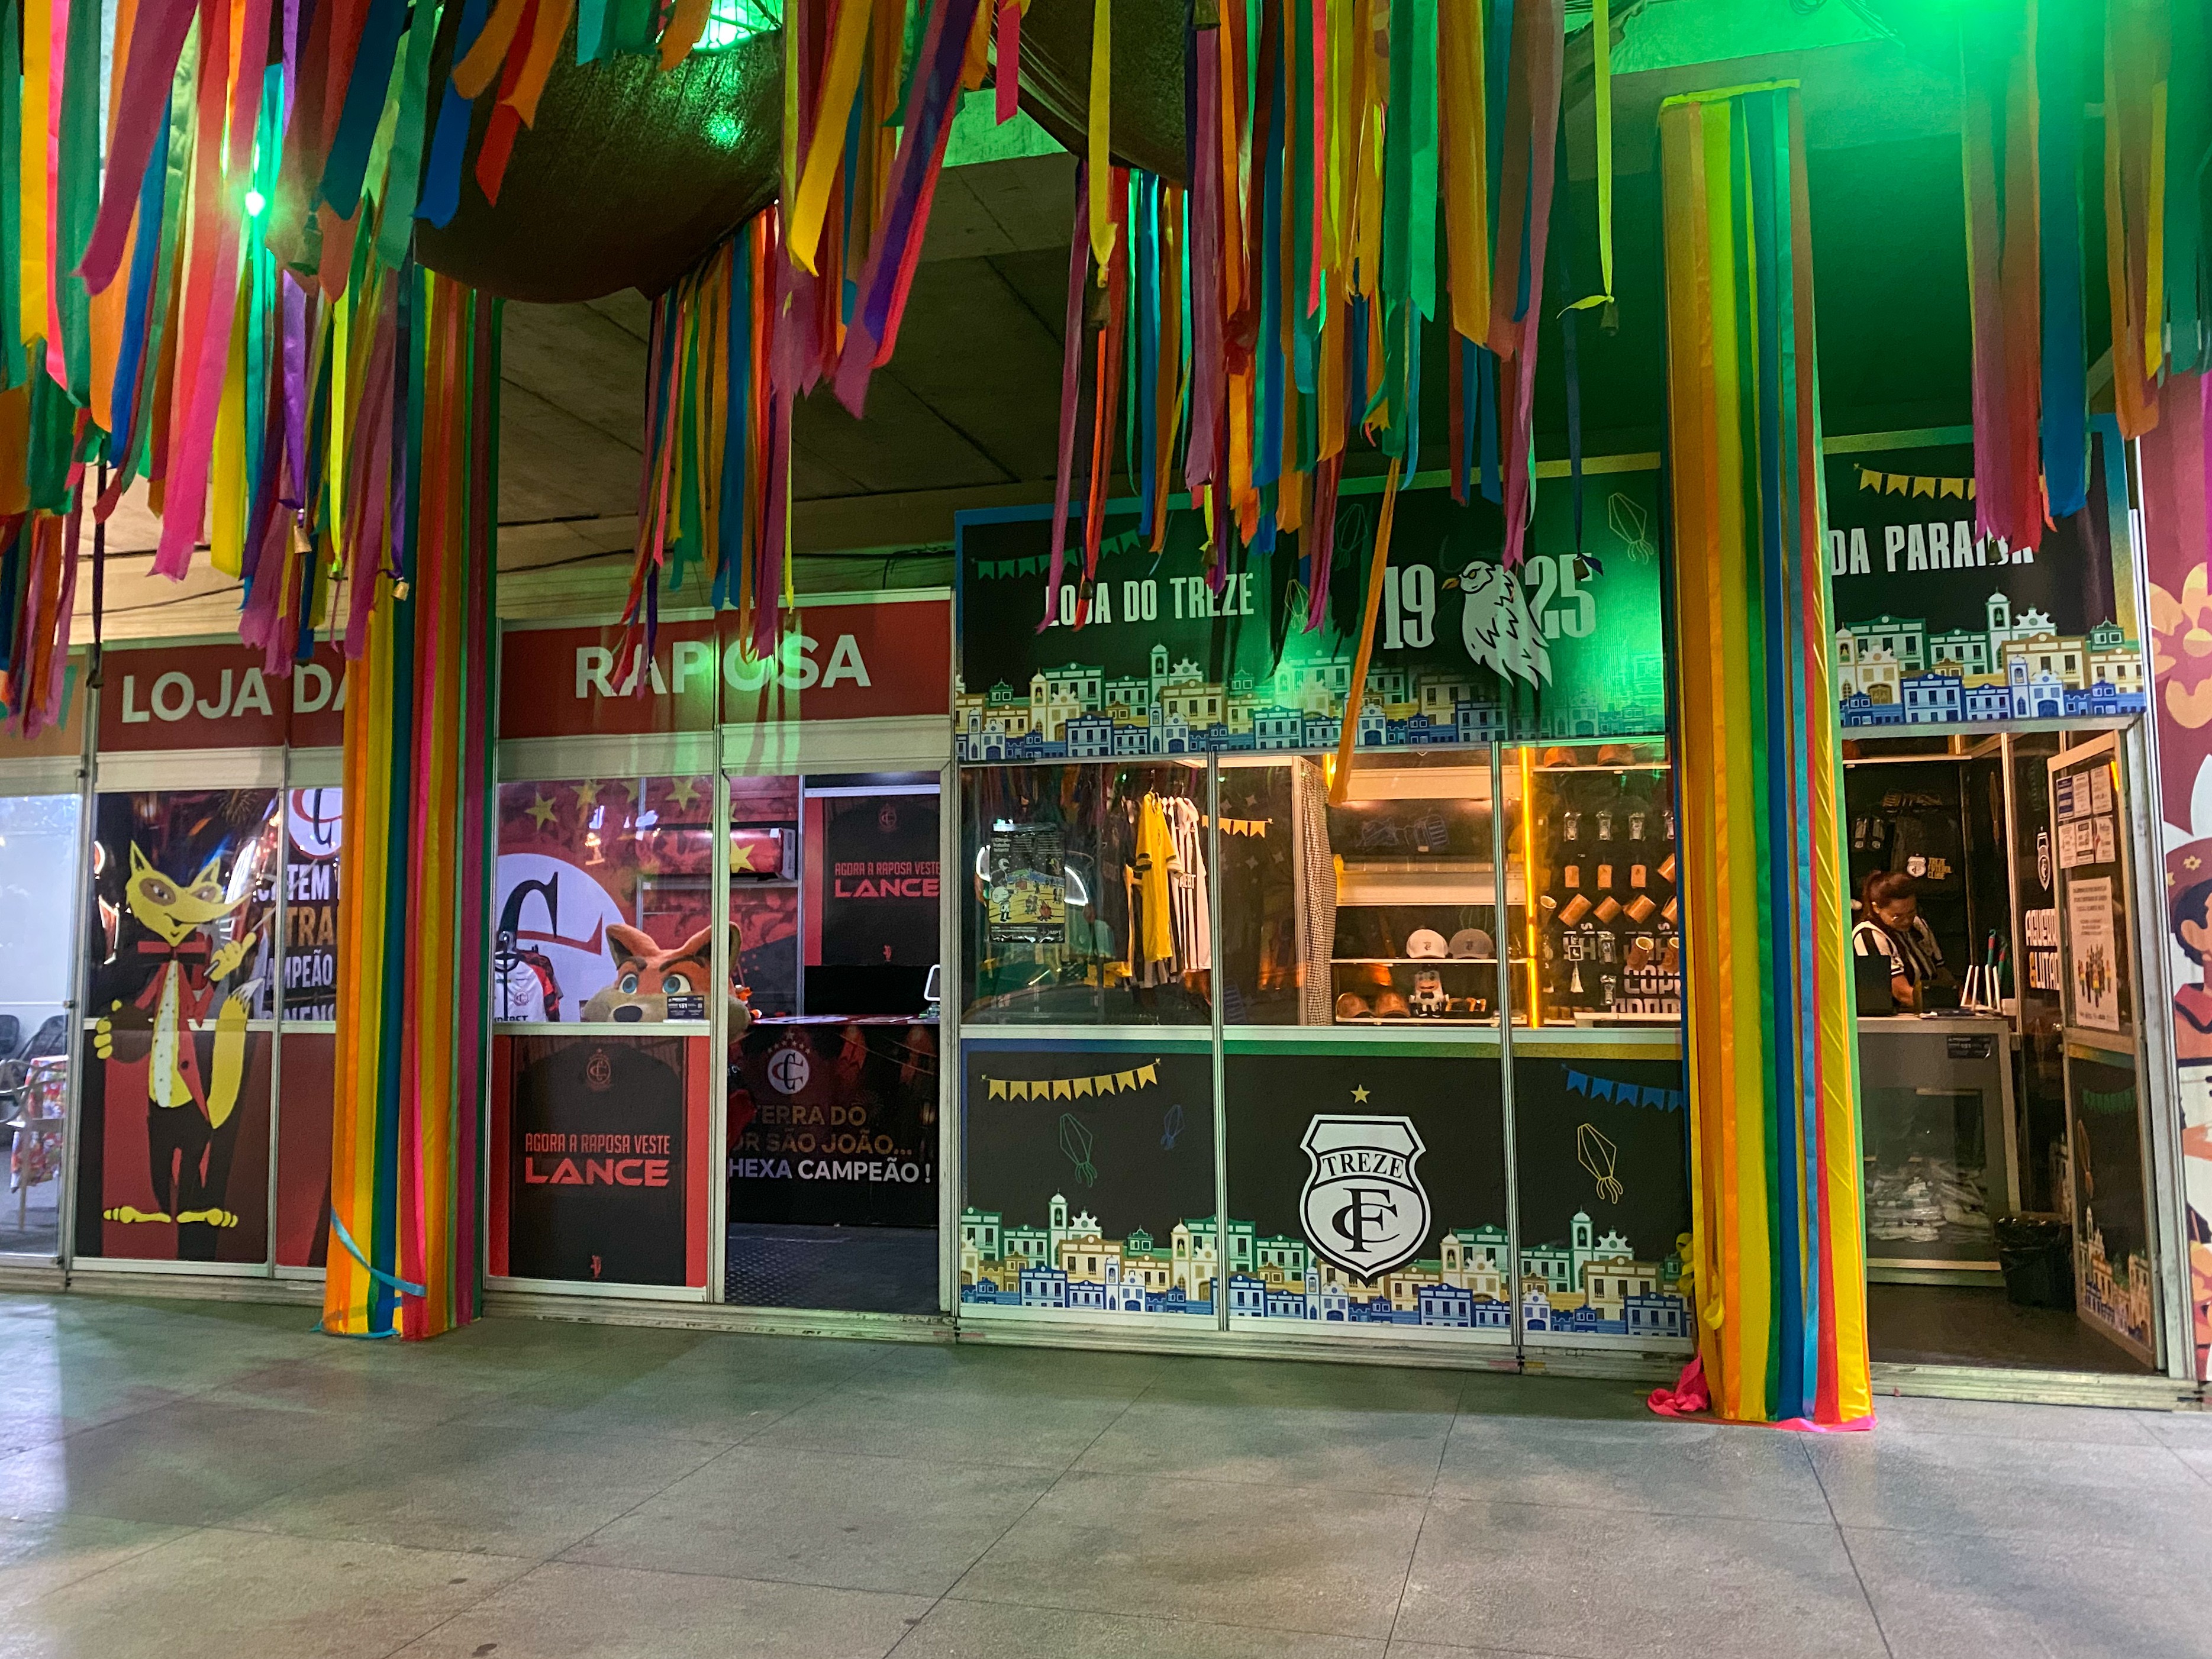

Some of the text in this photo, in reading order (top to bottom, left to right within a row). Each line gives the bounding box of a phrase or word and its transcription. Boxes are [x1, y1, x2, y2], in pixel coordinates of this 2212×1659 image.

[1828, 521, 2034, 576] DA PARAI
[1124, 579, 1157, 622] DO
[1169, 573, 1255, 619] TREZE
[1383, 564, 1436, 649] 19
[1525, 553, 1597, 639] 25
[576, 634, 872, 699] RAPOSA
[122, 667, 273, 723] LOJA
[287, 864, 330, 900] TEM
[835, 862, 865, 876] AGORA
[876, 861, 912, 876] RAPOSA
[835, 878, 940, 898] LANCE
[265, 950, 333, 991] AMPEÃO
[754, 1105, 867, 1126] ERRA DO
[525, 1132, 670, 1154] AGORA A RAPOSA VESTE
[766, 1128, 817, 1153] SÃO
[525, 1156, 670, 1187] LANCE
[728, 1158, 793, 1179] HEXA
[1322, 1152, 1404, 1179] TREZE
